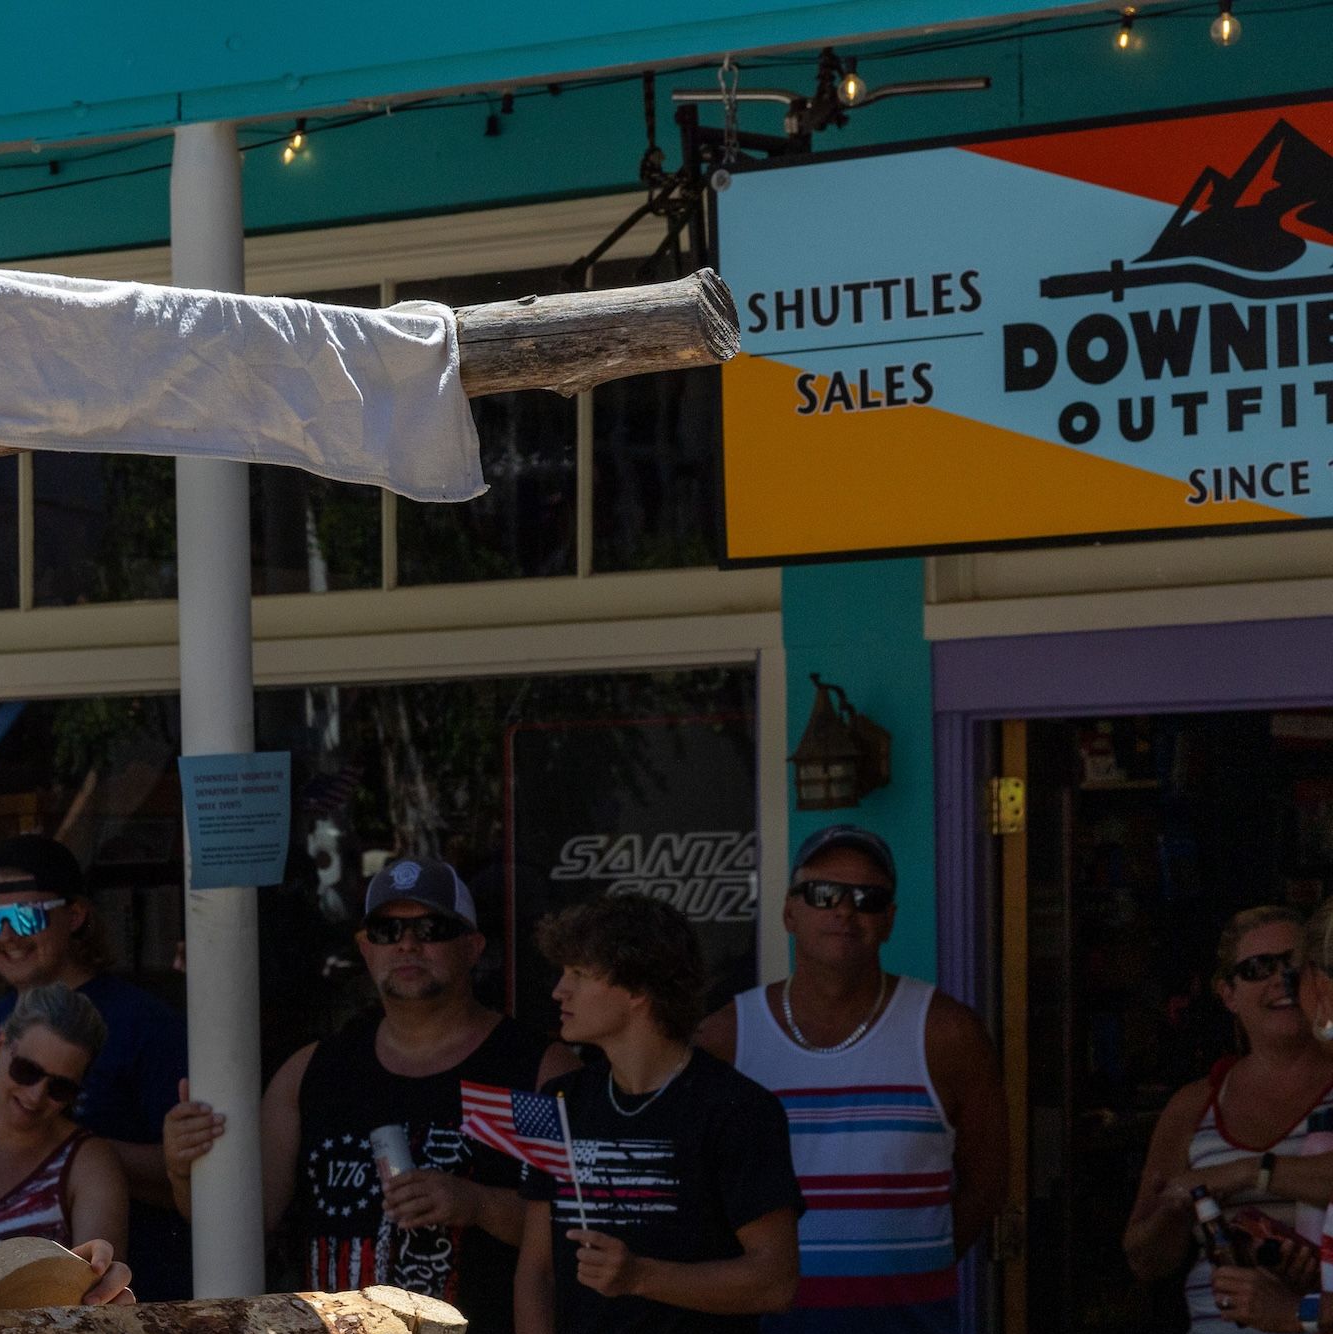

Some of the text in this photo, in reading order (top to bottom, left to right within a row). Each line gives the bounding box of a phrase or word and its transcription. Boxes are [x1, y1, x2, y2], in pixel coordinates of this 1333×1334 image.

[746, 269, 984, 335] SHUTTLES
[795, 361, 934, 417] SALES
[1185, 460, 1310, 505] SINCE
[549, 831, 758, 880] SANTA
[326, 1160, 371, 1188] 1776
